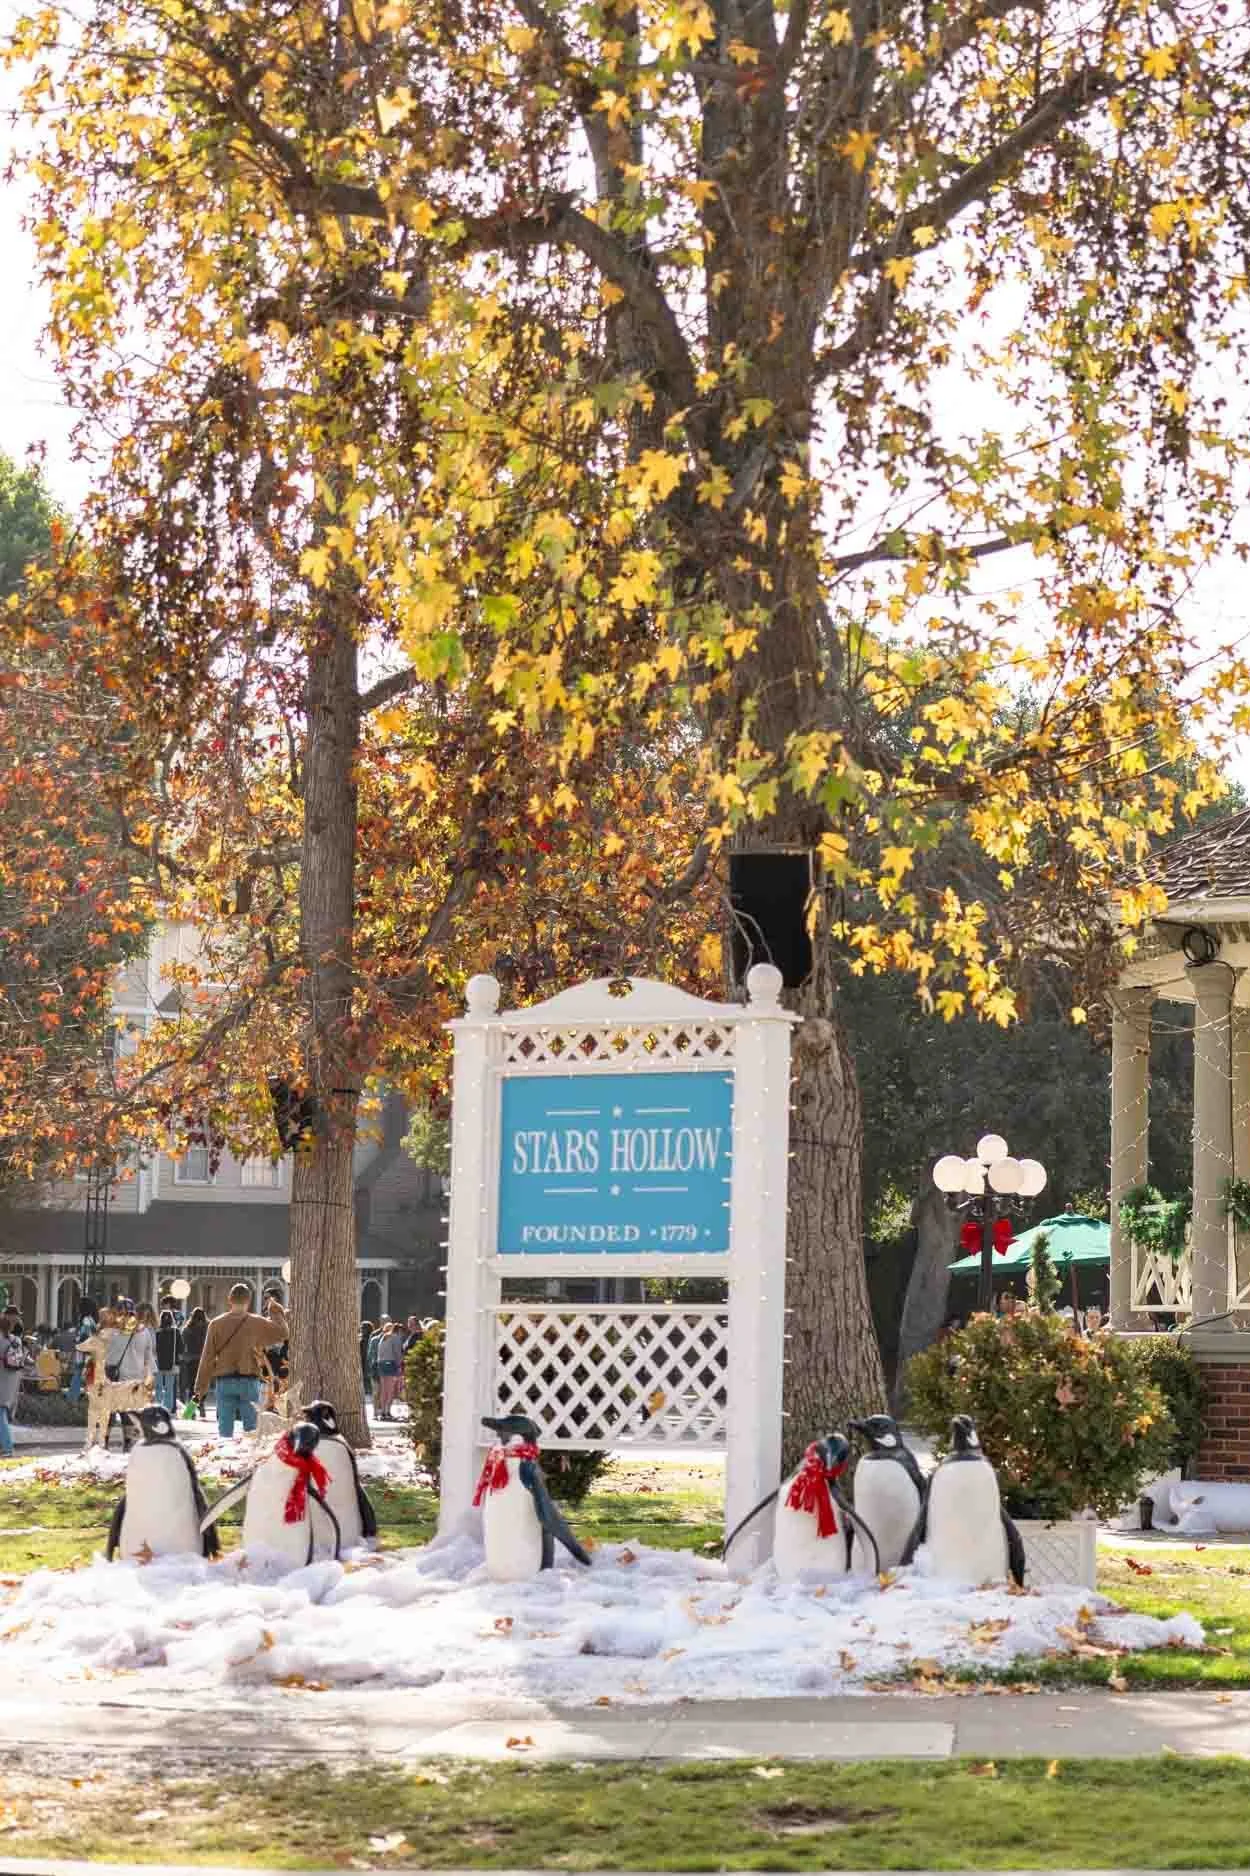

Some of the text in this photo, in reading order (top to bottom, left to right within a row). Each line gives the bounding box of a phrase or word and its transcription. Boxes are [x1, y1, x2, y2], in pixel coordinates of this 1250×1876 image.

[512, 1127, 723, 1175] STARS HOLLOW
[521, 1225, 641, 1243] FOUNDED
